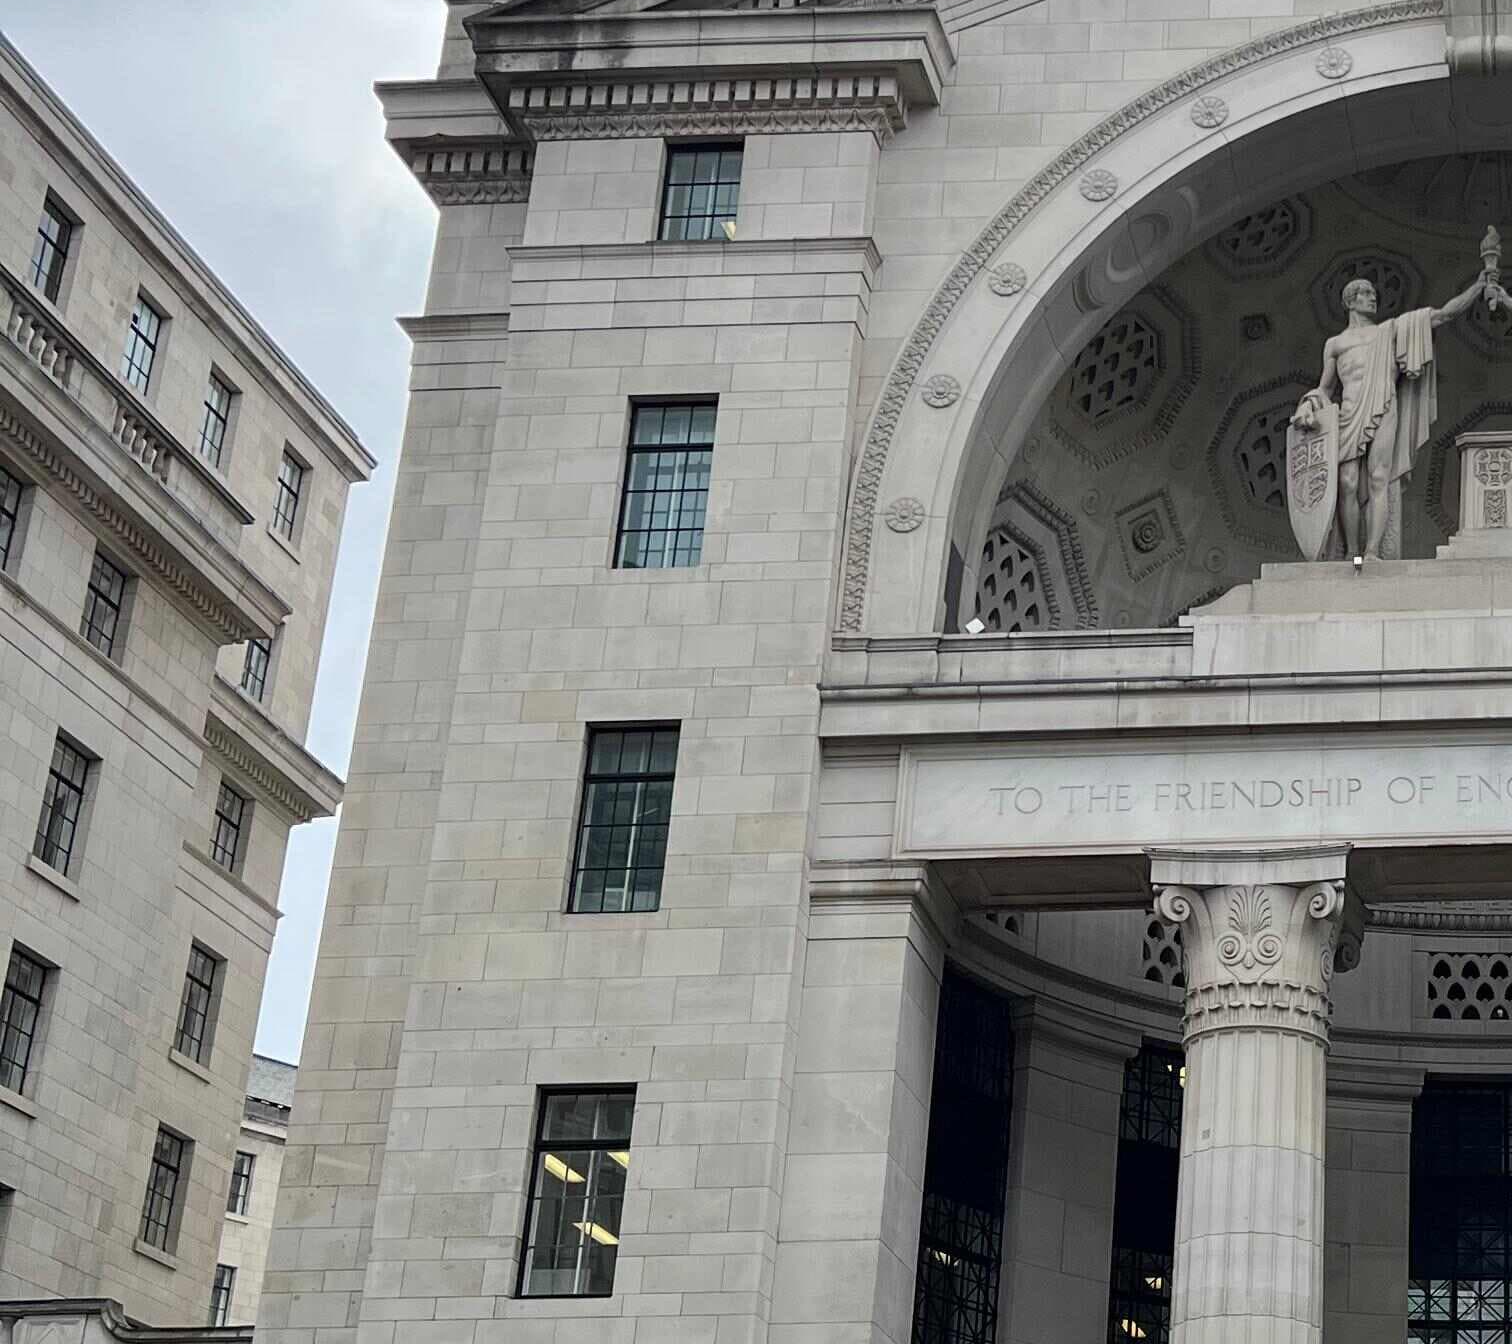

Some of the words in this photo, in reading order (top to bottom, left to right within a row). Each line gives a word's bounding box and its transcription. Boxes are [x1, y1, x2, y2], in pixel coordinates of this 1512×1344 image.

[988, 785, 1043, 816] TO
[1058, 783, 1132, 814] THE
[1152, 777, 1362, 812] FRIENDSHIP
[1386, 775, 1437, 805] OF
